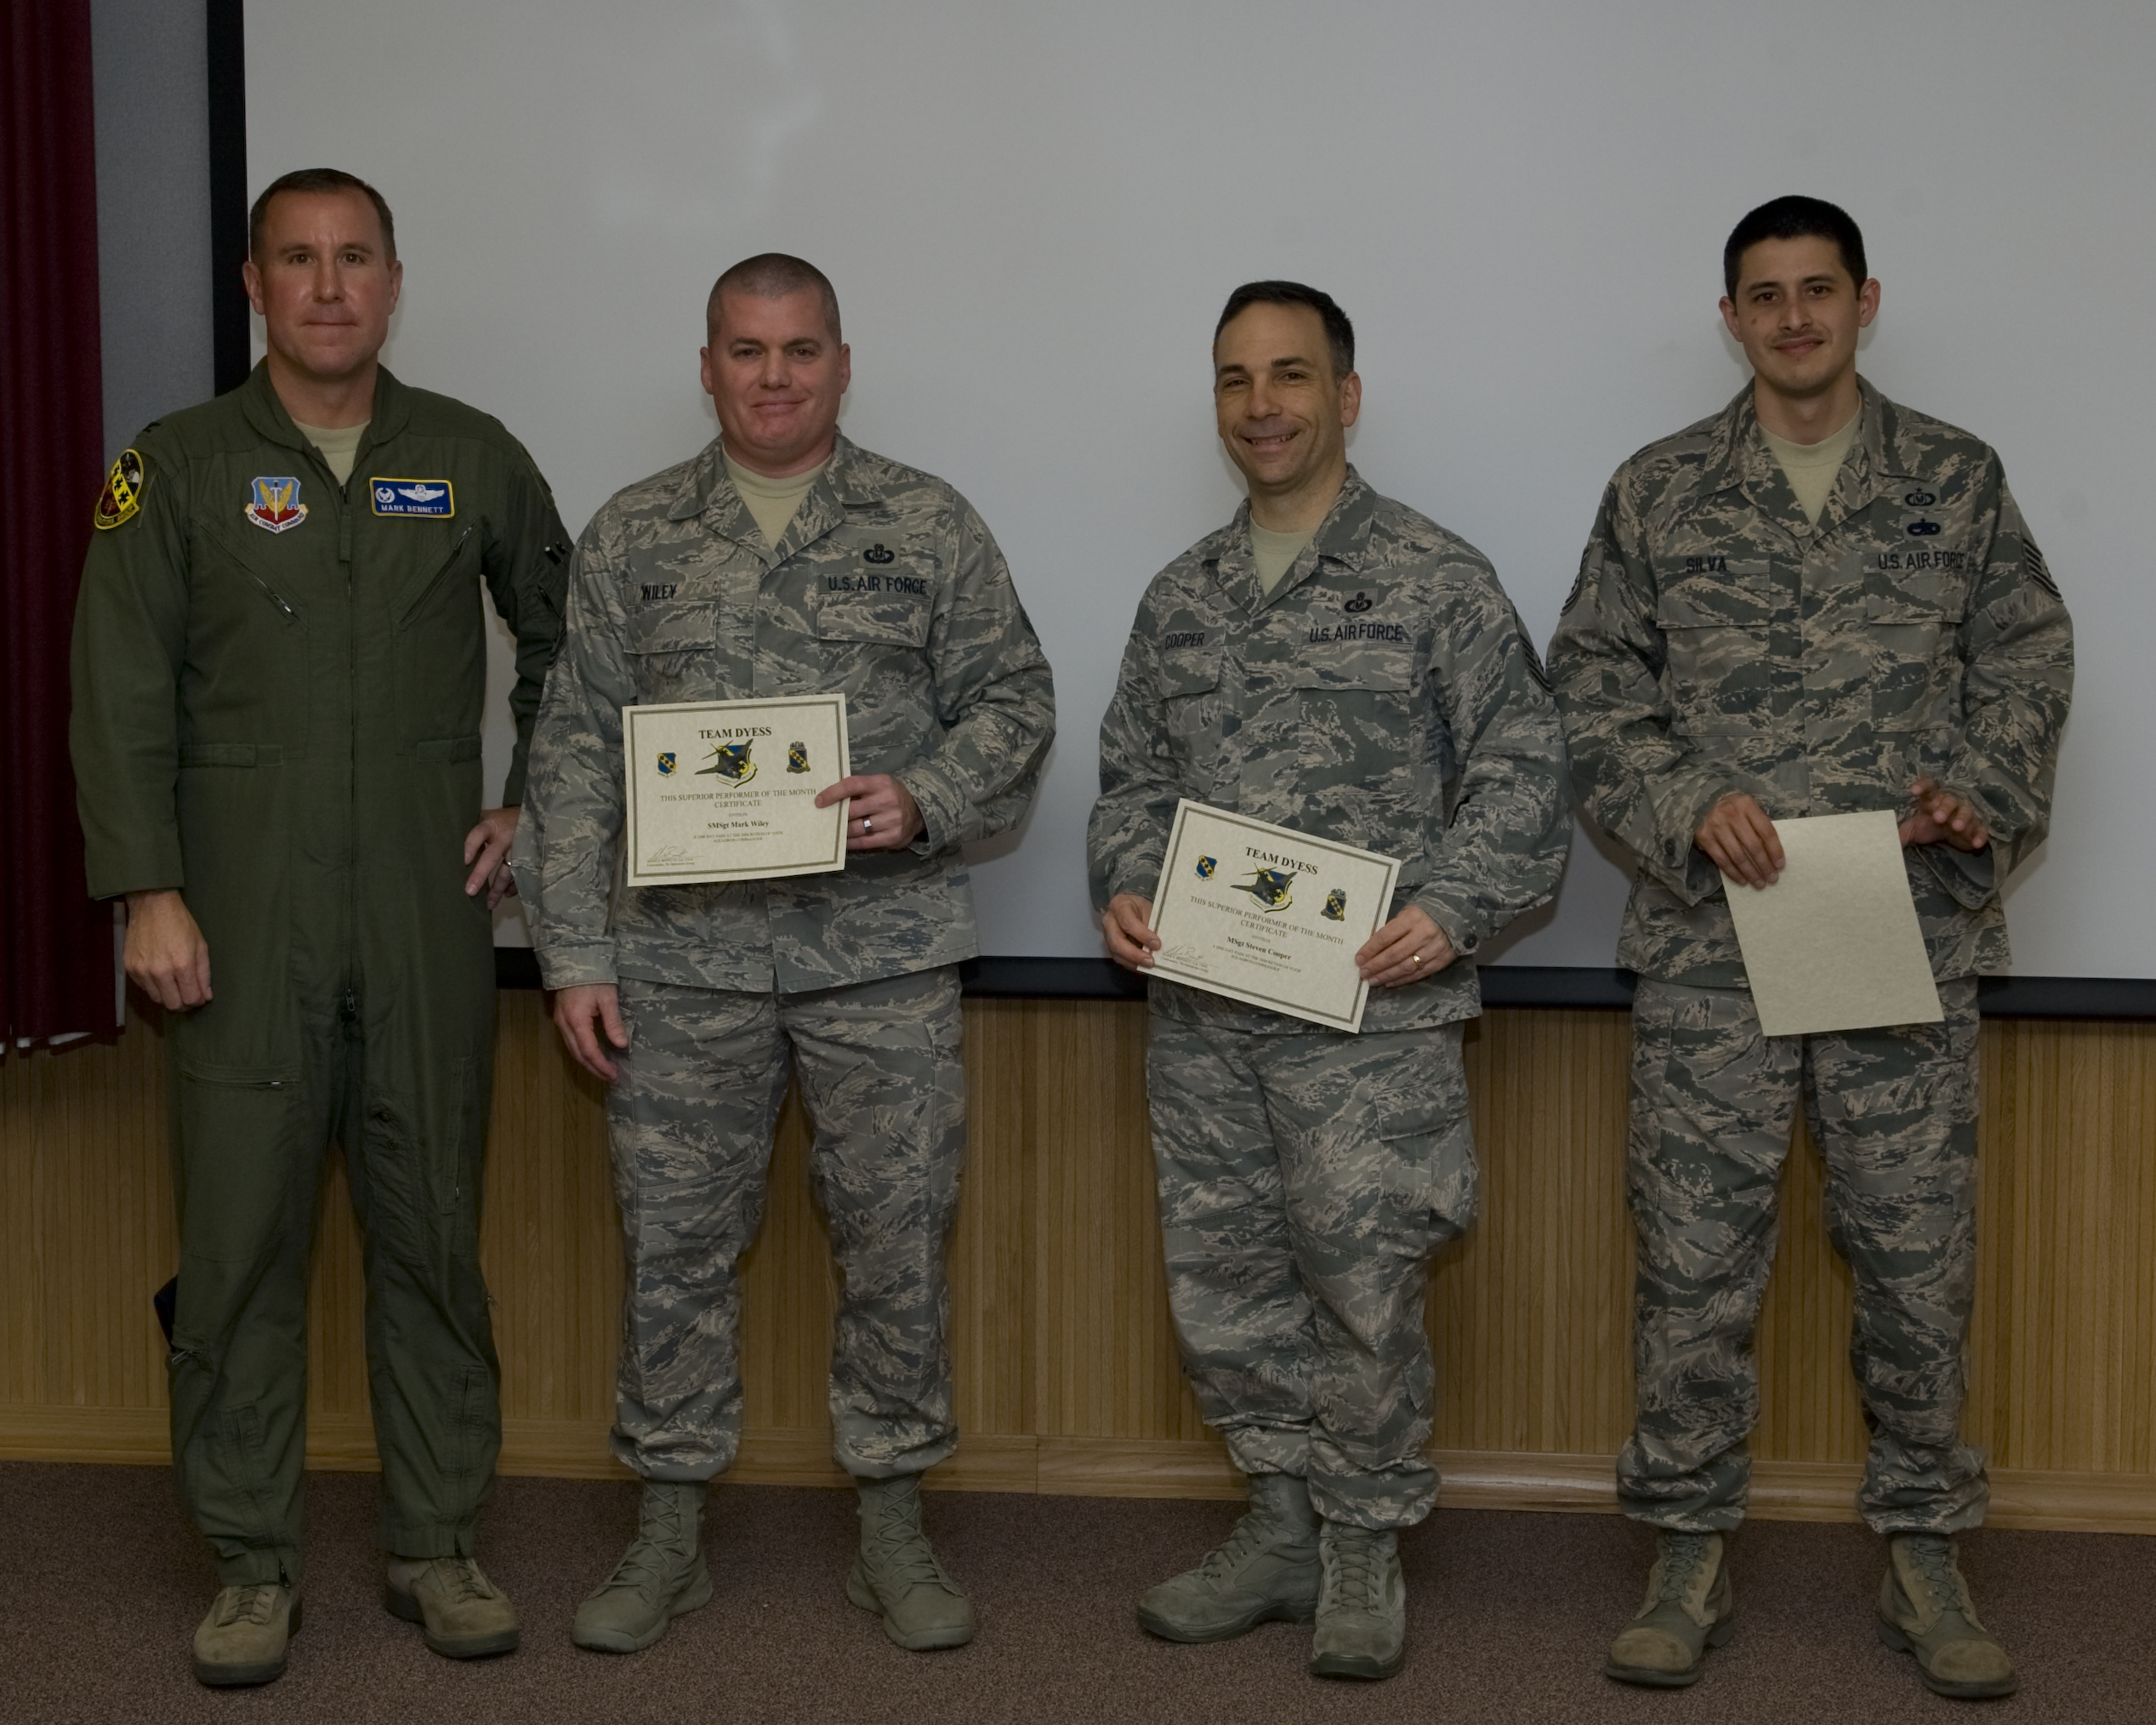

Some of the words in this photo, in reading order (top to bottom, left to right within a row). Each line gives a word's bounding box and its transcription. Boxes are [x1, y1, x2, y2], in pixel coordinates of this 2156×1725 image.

[407, 505, 444, 514] BENNETT
[1687, 556, 1728, 573] SILVA
[1878, 554, 1903, 570] U.S.
[1906, 553, 1931, 569] AIR
[1934, 551, 1966, 569] FORCE
[641, 584, 678, 601] WILEY
[828, 576, 855, 592] U.S.
[857, 576, 881, 592] AIR
[886, 577, 929, 595] FORCE
[1165, 632, 1205, 650] COOPER
[1309, 628, 1331, 644] U.S.
[1334, 625, 1357, 641] AIR
[1358, 623, 1404, 642] FORCE
[698, 729, 732, 739] TEAM
[736, 726, 772, 737] DYESS
[678, 793, 714, 801] SUPERIOR
[715, 791, 759, 800] PERFORMER
[714, 800, 762, 808] CERTIFICATE
[750, 820, 769, 828] Wiley
[1245, 846, 1279, 864] TEAM
[1281, 857, 1318, 875] DYESS
[1191, 896, 1207, 906] THIS
[1208, 900, 1243, 916] SUPERIOR
[1243, 911, 1288, 929] PERFORMER
[1288, 924, 1299, 932] OF
[1300, 927, 1315, 937] THE
[1316, 931, 1344, 945] MONTH
[1240, 919, 1288, 938] CERTIFICATE
[1226, 936, 1244, 948] MSgt
[1245, 942, 1266, 954] Steven
[1268, 948, 1292, 960] Cooper
